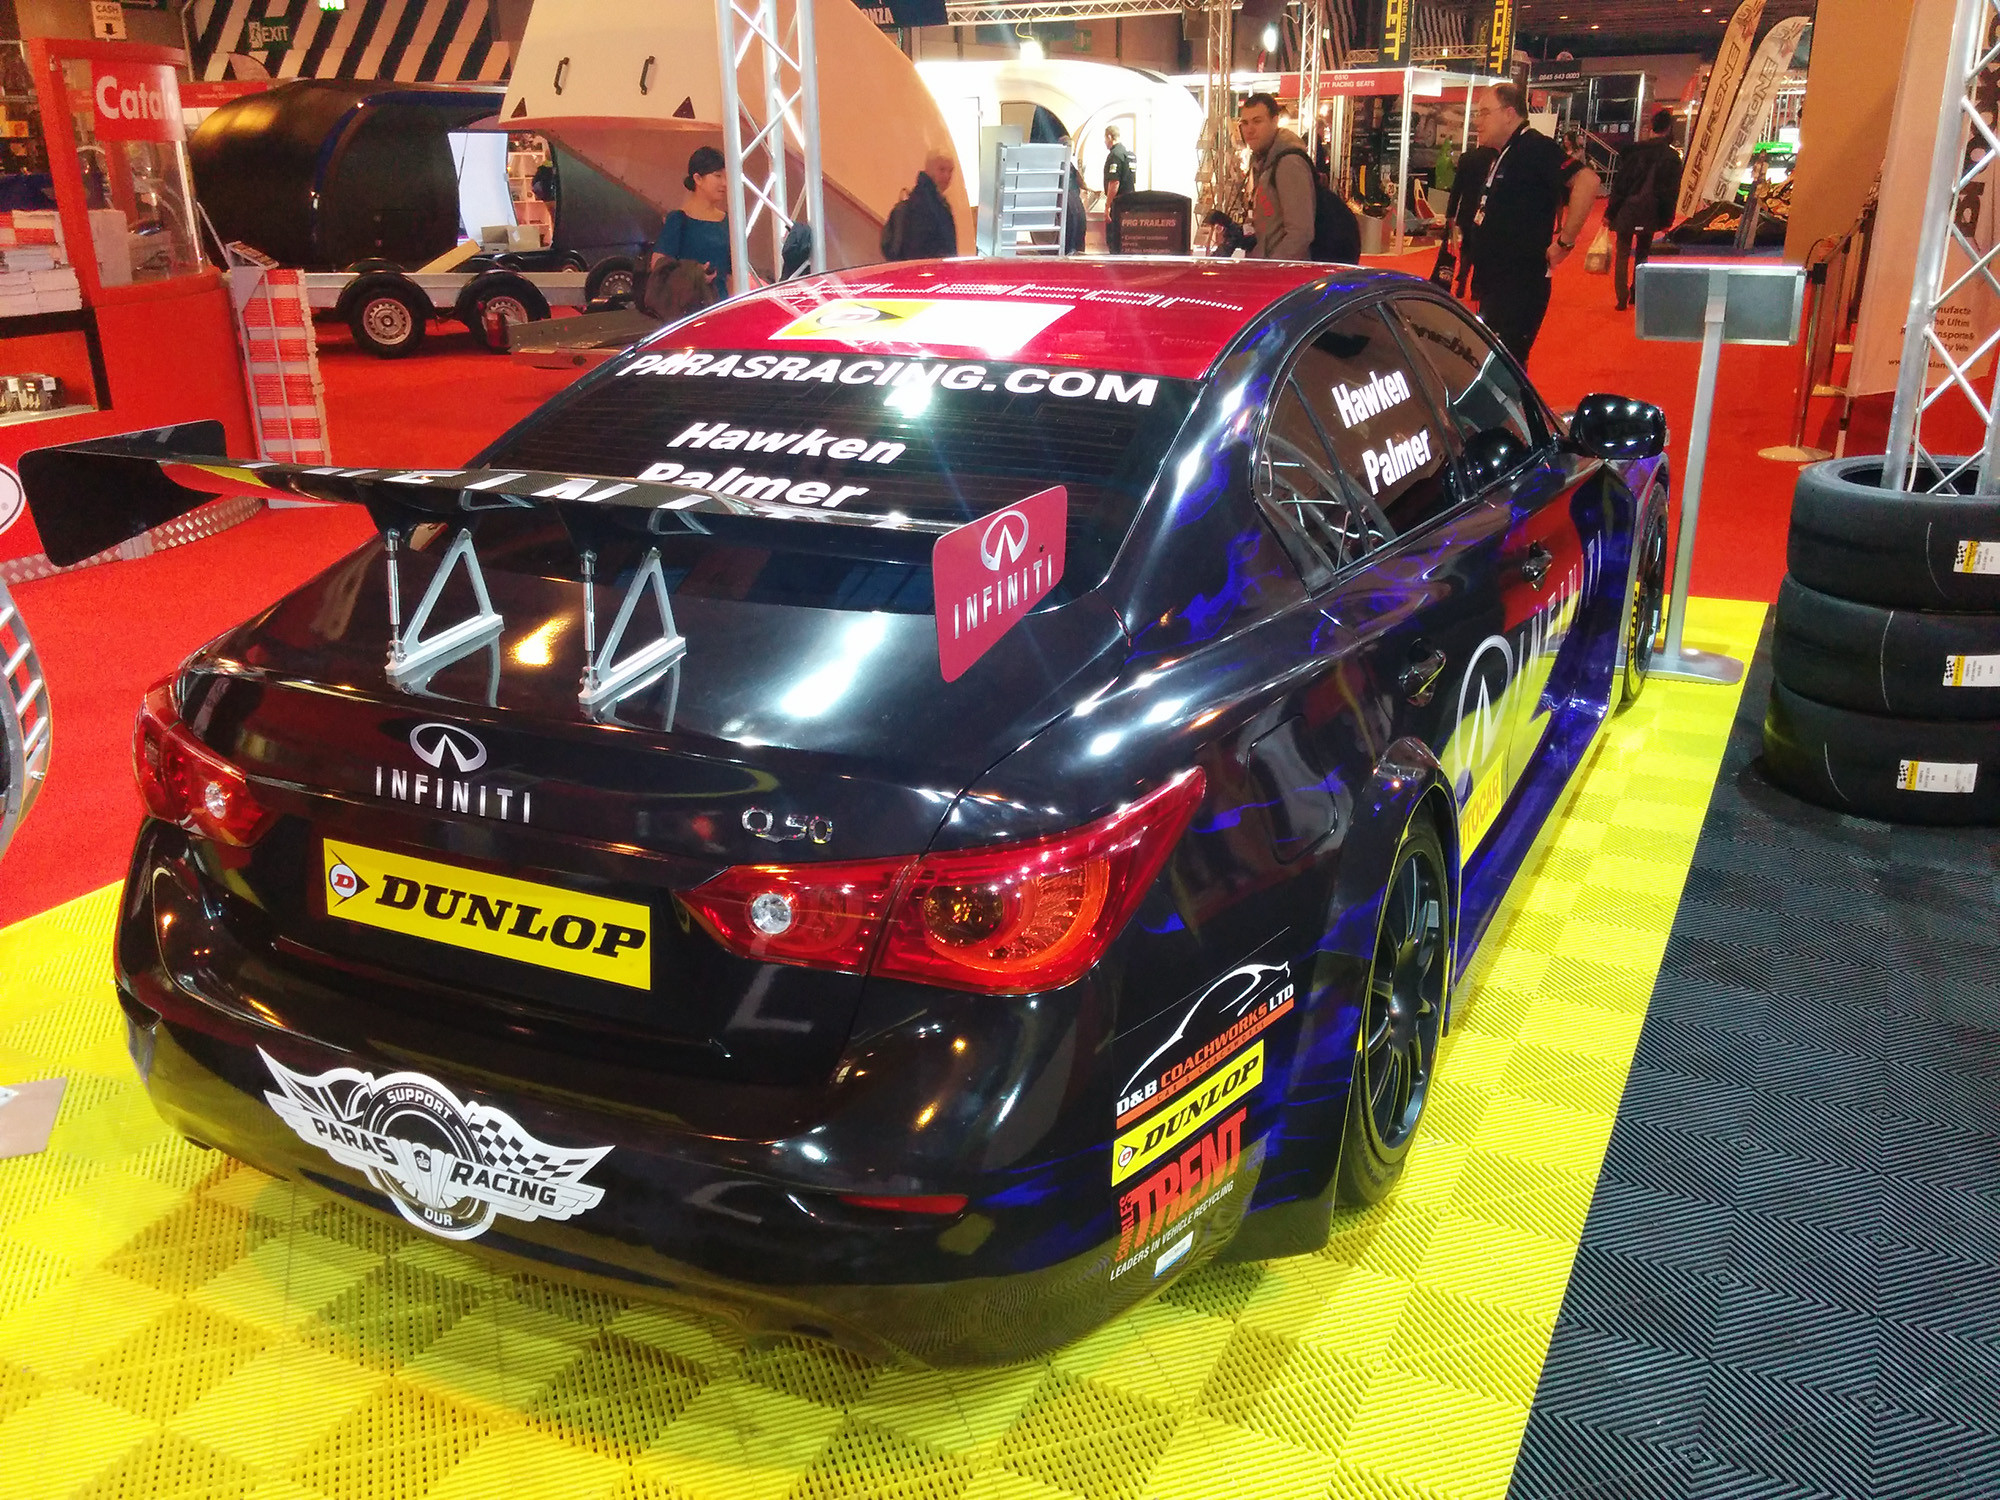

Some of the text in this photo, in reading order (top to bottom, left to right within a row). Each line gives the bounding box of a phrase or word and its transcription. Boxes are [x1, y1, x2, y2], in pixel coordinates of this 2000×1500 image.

[95, 4, 119, 14] CASH
[262, 25, 289, 42] EXIT
[860, 7, 894, 24] ONZA
[1489, 0, 1508, 74] ILLETT
[1332, 80, 1354, 88] RACING
[1356, 80, 1375, 88] SEATS
[1681, 41, 1740, 217] SUPERONE
[1713, 56, 1778, 200] SUPERONE
[1140, 219, 1177, 227] TRAILERS
[615, 352, 1159, 406] PARASRACING.COM
[1331, 370, 1412, 428] Hawken
[667, 422, 907, 465] Hawken
[1361, 429, 1432, 496] Palmer
[637, 462, 871, 508] Palmer
[954, 554, 1052, 640] INFINITI
[375, 766, 532, 824] INFINITI
[741, 806, 833, 844] Q50
[374, 874, 647, 959] DUNLOP
[1116, 983, 1294, 1117] D&B COACHWORKS LTD
[386, 1088, 453, 1119] SUPPORT
[1139, 1055, 1260, 1157] DUNLOP
[312, 1116, 557, 1207] PARAS RACING
[1126, 1107, 1247, 1249] TRENT
[1110, 1246, 1150, 1282] LEADERS
[1151, 1237, 1161, 1253] IN
[1162, 1211, 1194, 1245] VEHICLE
[1193, 1180, 1234, 1220] RECYCLING
